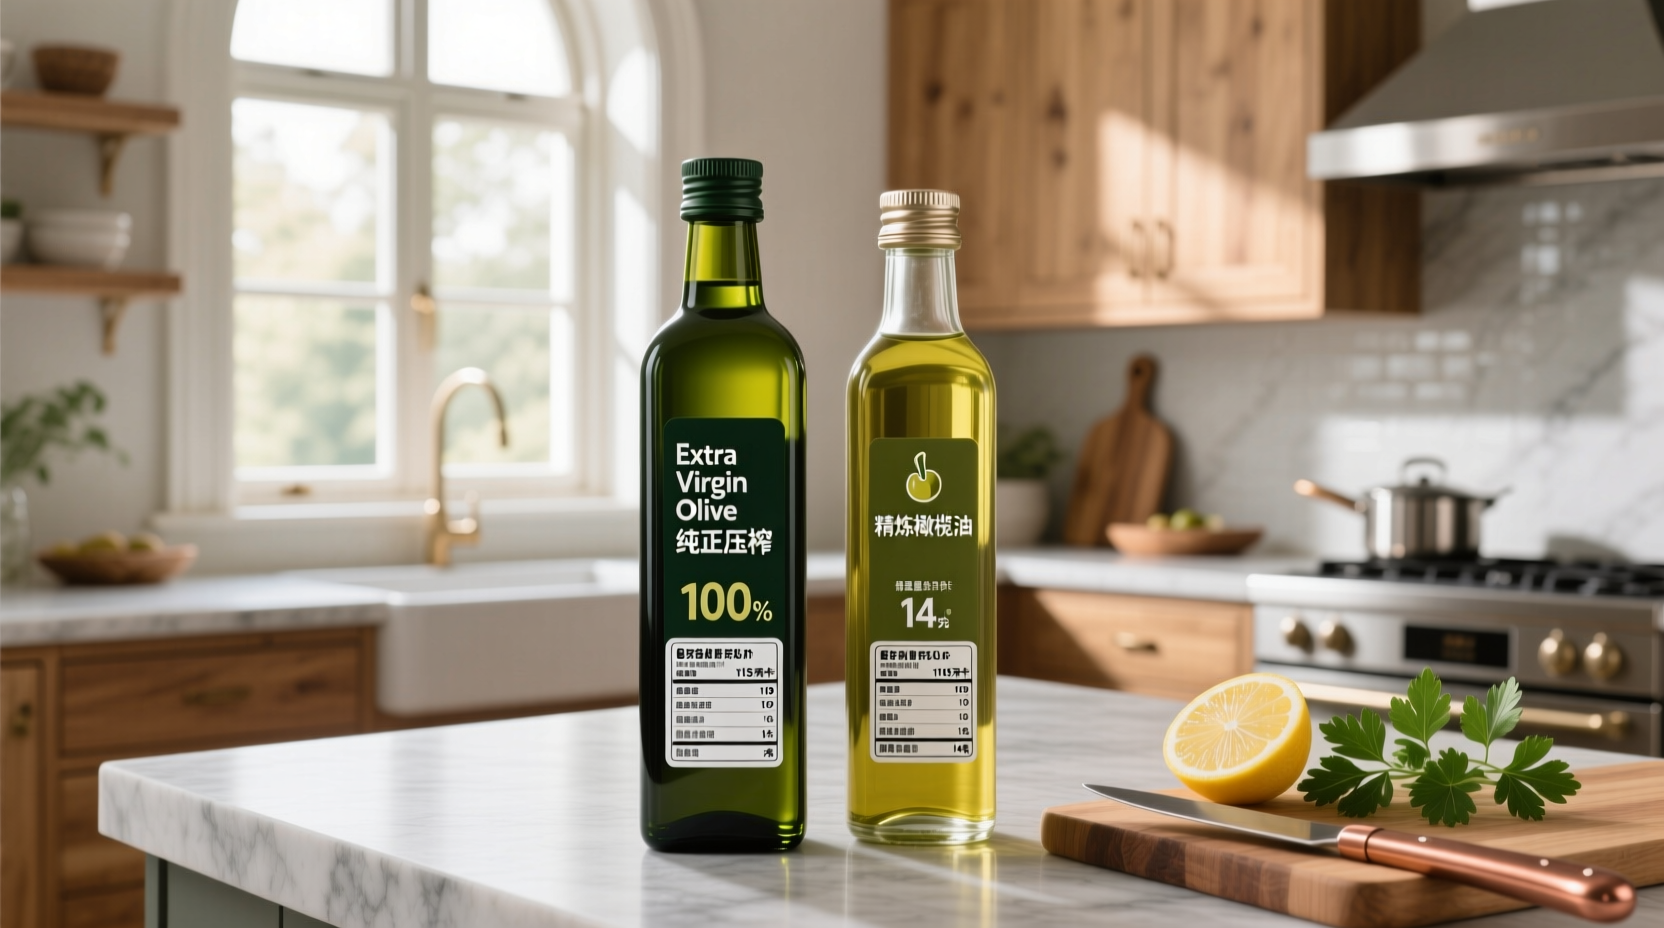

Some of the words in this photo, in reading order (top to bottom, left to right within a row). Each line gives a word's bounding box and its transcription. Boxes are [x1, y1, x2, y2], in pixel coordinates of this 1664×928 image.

[676, 442, 737, 466] Extra
[676, 470, 748, 500] Virgin
[675, 498, 738, 522] Olive
[680, 581, 773, 622] 100%
